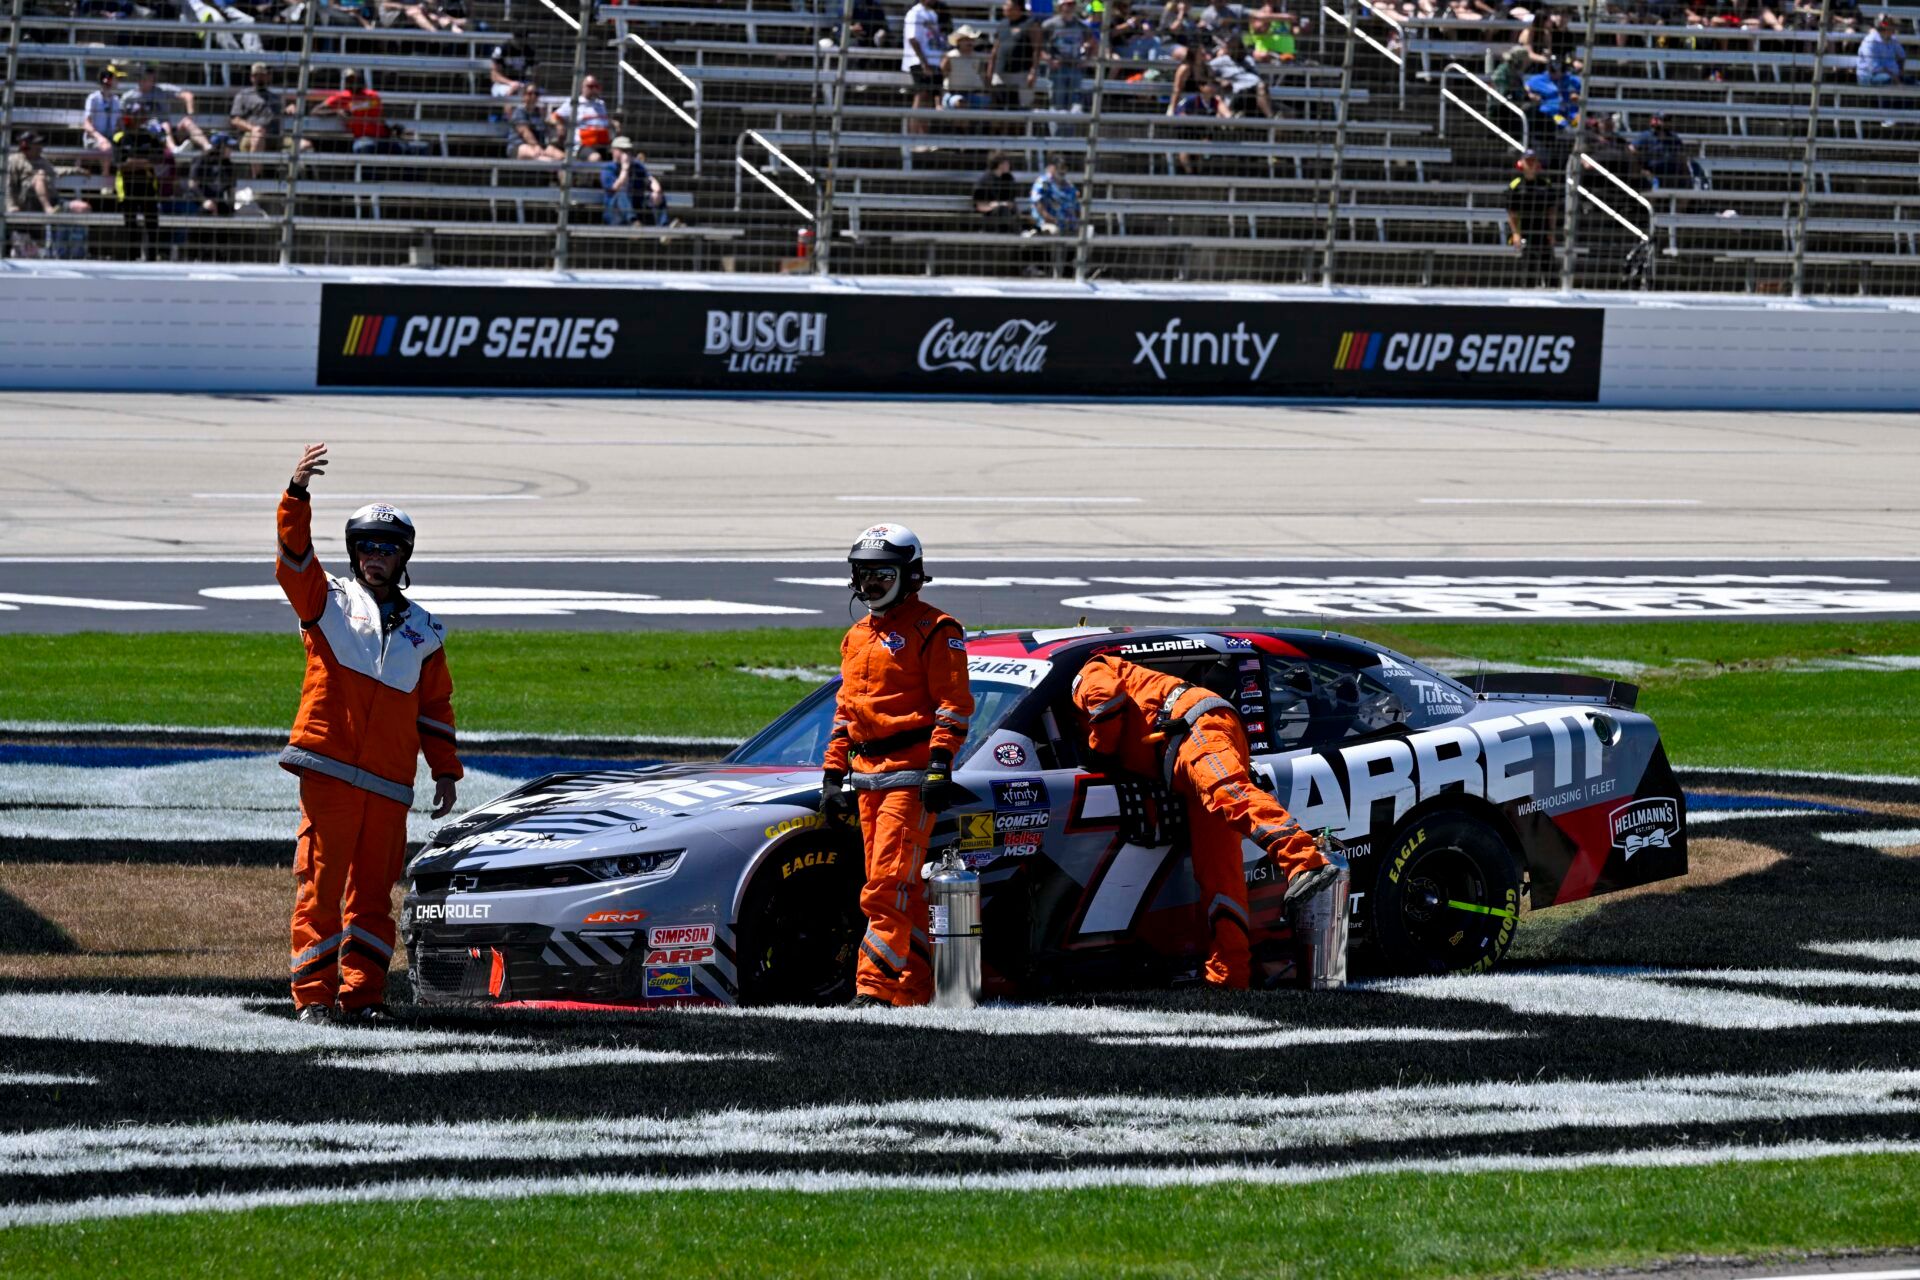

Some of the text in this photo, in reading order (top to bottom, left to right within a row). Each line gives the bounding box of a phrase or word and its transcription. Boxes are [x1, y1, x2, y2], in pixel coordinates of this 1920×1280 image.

[399, 316, 619, 359] CUP SERIES
[704, 311, 827, 356] BUSCH
[1133, 317, 1279, 380] xfinity
[1383, 333, 1576, 374] CUP SERIES
[728, 353, 798, 373] LIGHT
[967, 661, 1028, 676] GAIER
[1410, 680, 1462, 704] Tufco
[1427, 705, 1464, 716] FLOORING
[997, 744, 1019, 754] NASCAR
[1250, 705, 1612, 840] ARRETT
[1002, 788, 1038, 804] xfinity
[1517, 779, 1616, 817] WAREHOUSING FLEET
[996, 812, 1049, 828] COMETIC
[1614, 802, 1674, 835] HELLMANN'S
[1003, 831, 1041, 847] Holley
[1003, 845, 1037, 857] MSD
[1388, 828, 1427, 884] EAGLE
[781, 851, 838, 879] EAGLE
[416, 904, 492, 919] CHEVROLET
[587, 913, 640, 923] JRM
[653, 928, 710, 944] SIMPSON
[645, 948, 714, 964] ARP
[650, 976, 688, 986] SUNOCO
